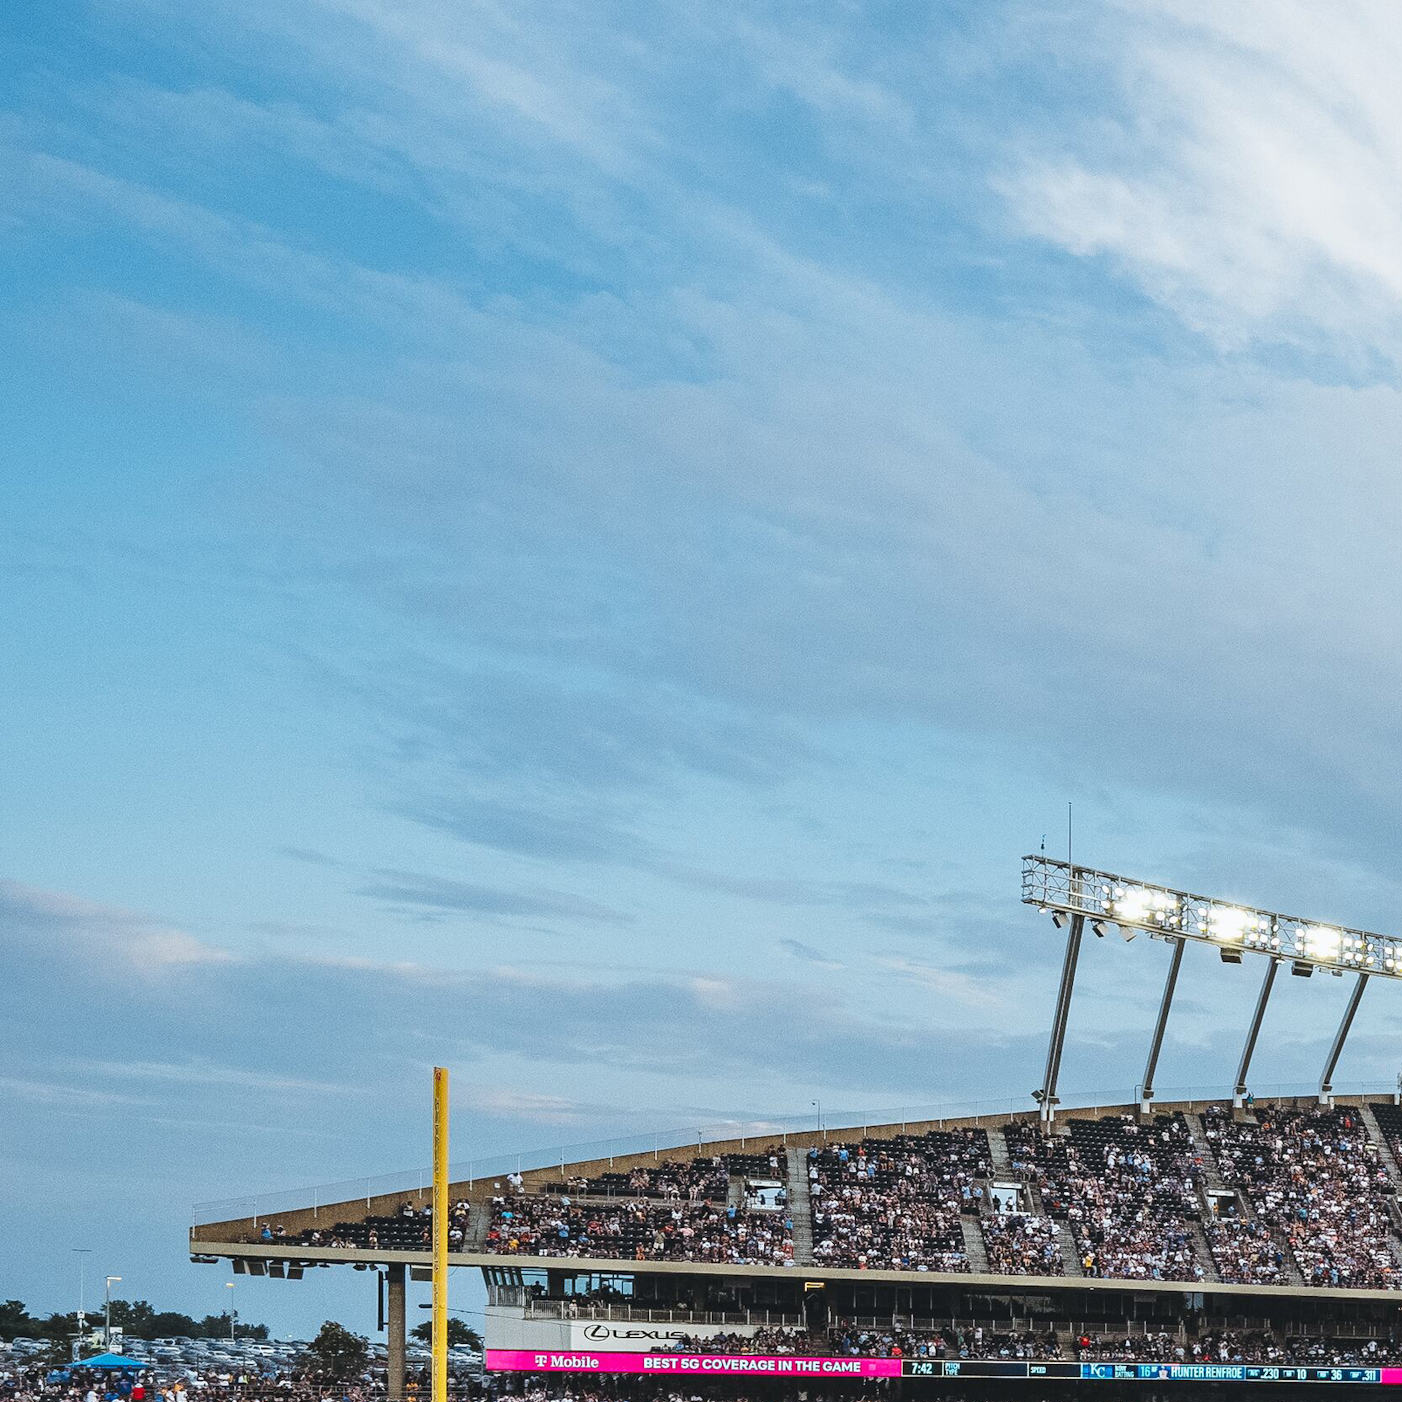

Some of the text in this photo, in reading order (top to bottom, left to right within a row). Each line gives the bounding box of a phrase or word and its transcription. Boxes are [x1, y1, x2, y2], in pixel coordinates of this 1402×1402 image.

[612, 1330, 686, 1340] LEXUS
[551, 1355, 599, 1369] Mobile
[643, 1357, 862, 1373] BEST 5G COVERAGE IN THE GAME
[911, 1363, 933, 1375] 7:42
[1140, 1366, 1150, 1377] 16
[1171, 1366, 1242, 1379] HUNTER RENFROE
[1261, 1369, 1279, 1380] .230
[1296, 1370, 1307, 1381] 10
[1330, 1371, 1342, 1381] 36
[1362, 1371, 1376, 1381] .311
